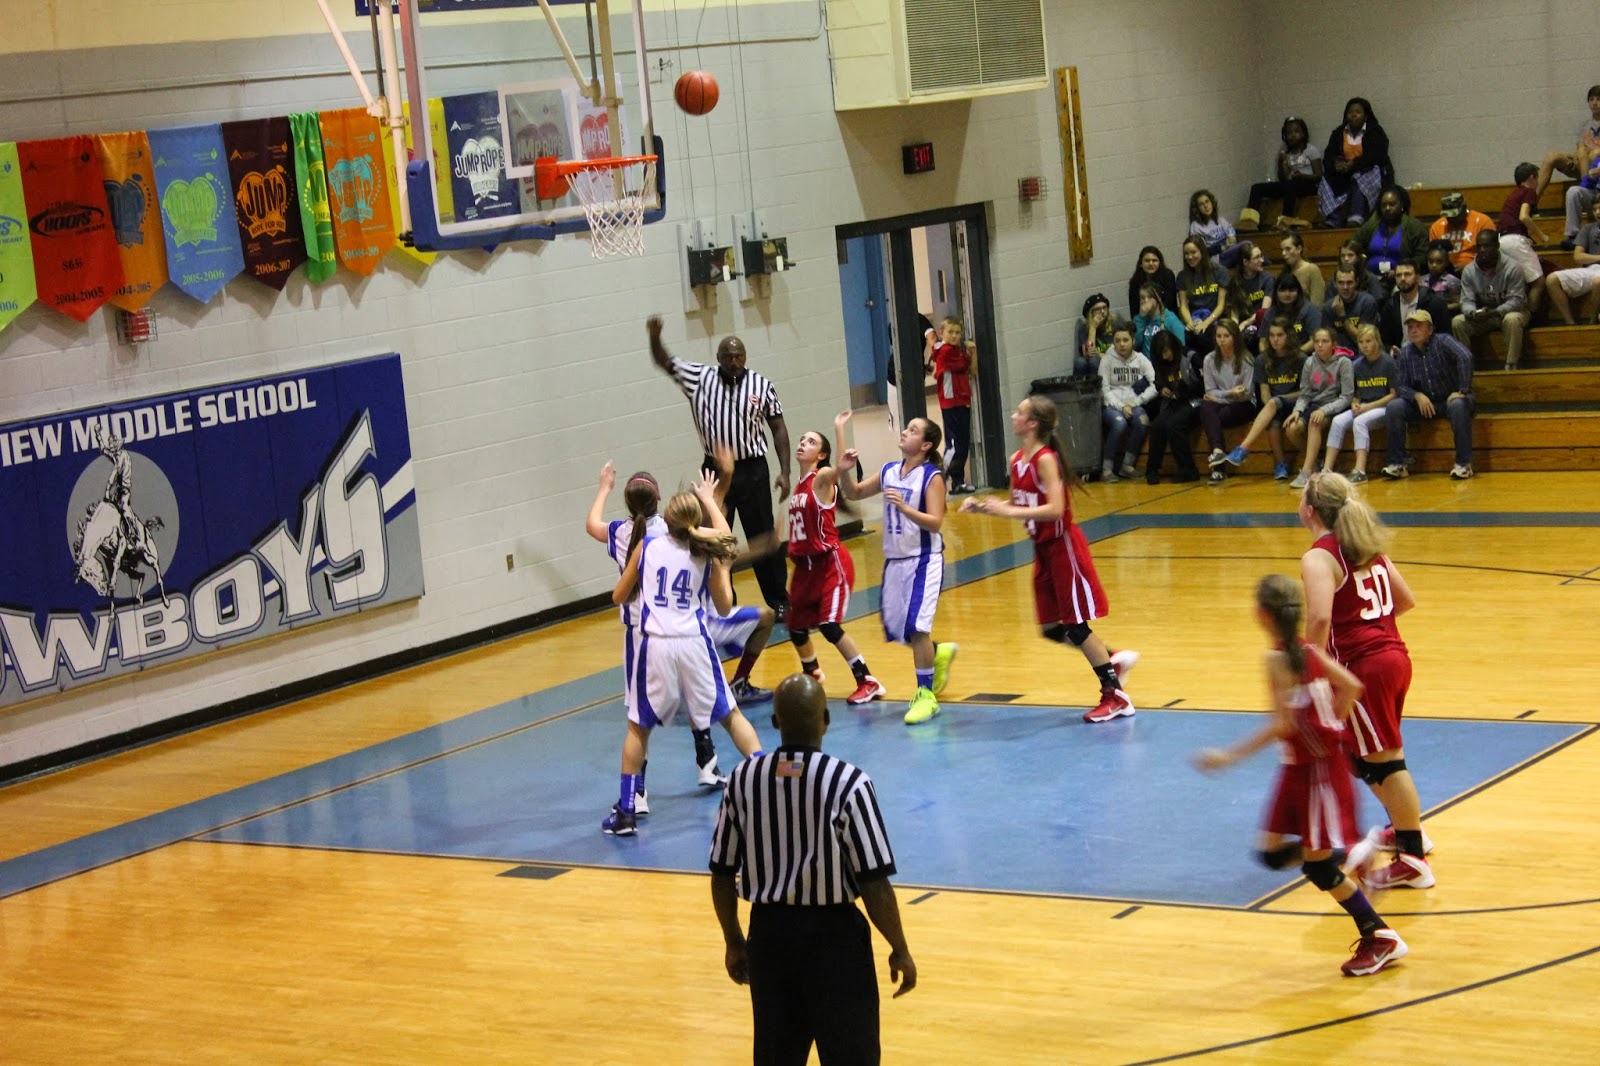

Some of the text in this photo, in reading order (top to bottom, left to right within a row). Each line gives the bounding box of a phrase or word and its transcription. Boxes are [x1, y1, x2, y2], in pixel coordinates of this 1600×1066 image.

[455, 147, 506, 178] JUMP ROPE
[913, 145, 930, 171] EXIT
[246, 176, 287, 220] JUMP
[44, 210, 92, 232] HOOPS
[0, 378, 317, 467] IEW MIDDLE SCHOOL
[0, 408, 390, 693] WBOYS
[654, 566, 693, 610] 14
[1353, 564, 1394, 620] 50
